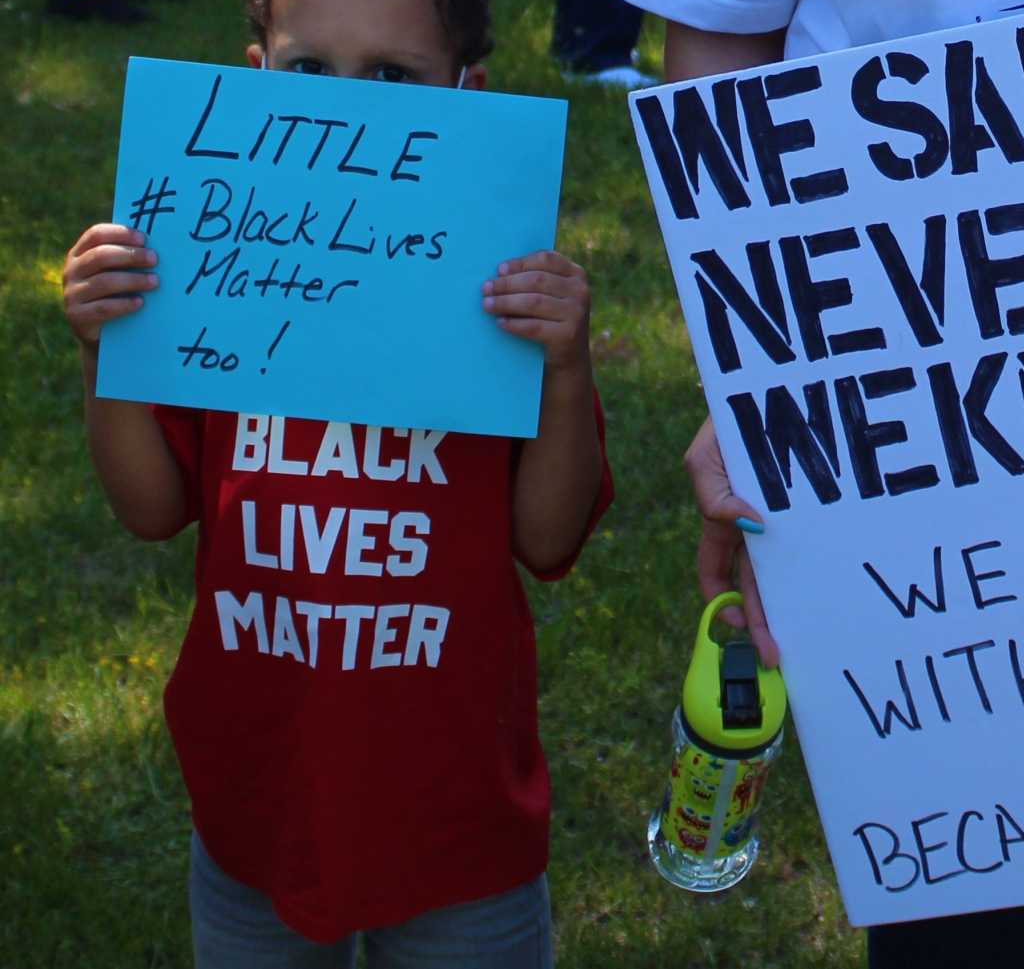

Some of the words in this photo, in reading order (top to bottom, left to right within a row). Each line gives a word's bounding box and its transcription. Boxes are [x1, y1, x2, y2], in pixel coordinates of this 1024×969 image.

[184, 73, 439, 183] LITTLE
[634, 64, 850, 221] WE
[184, 247, 361, 304] Matter
[231, 411, 450, 485] BLACK
[241, 500, 431, 577] LIVES
[862, 539, 1018, 619] WE
[213, 589, 451, 671] MATTER
